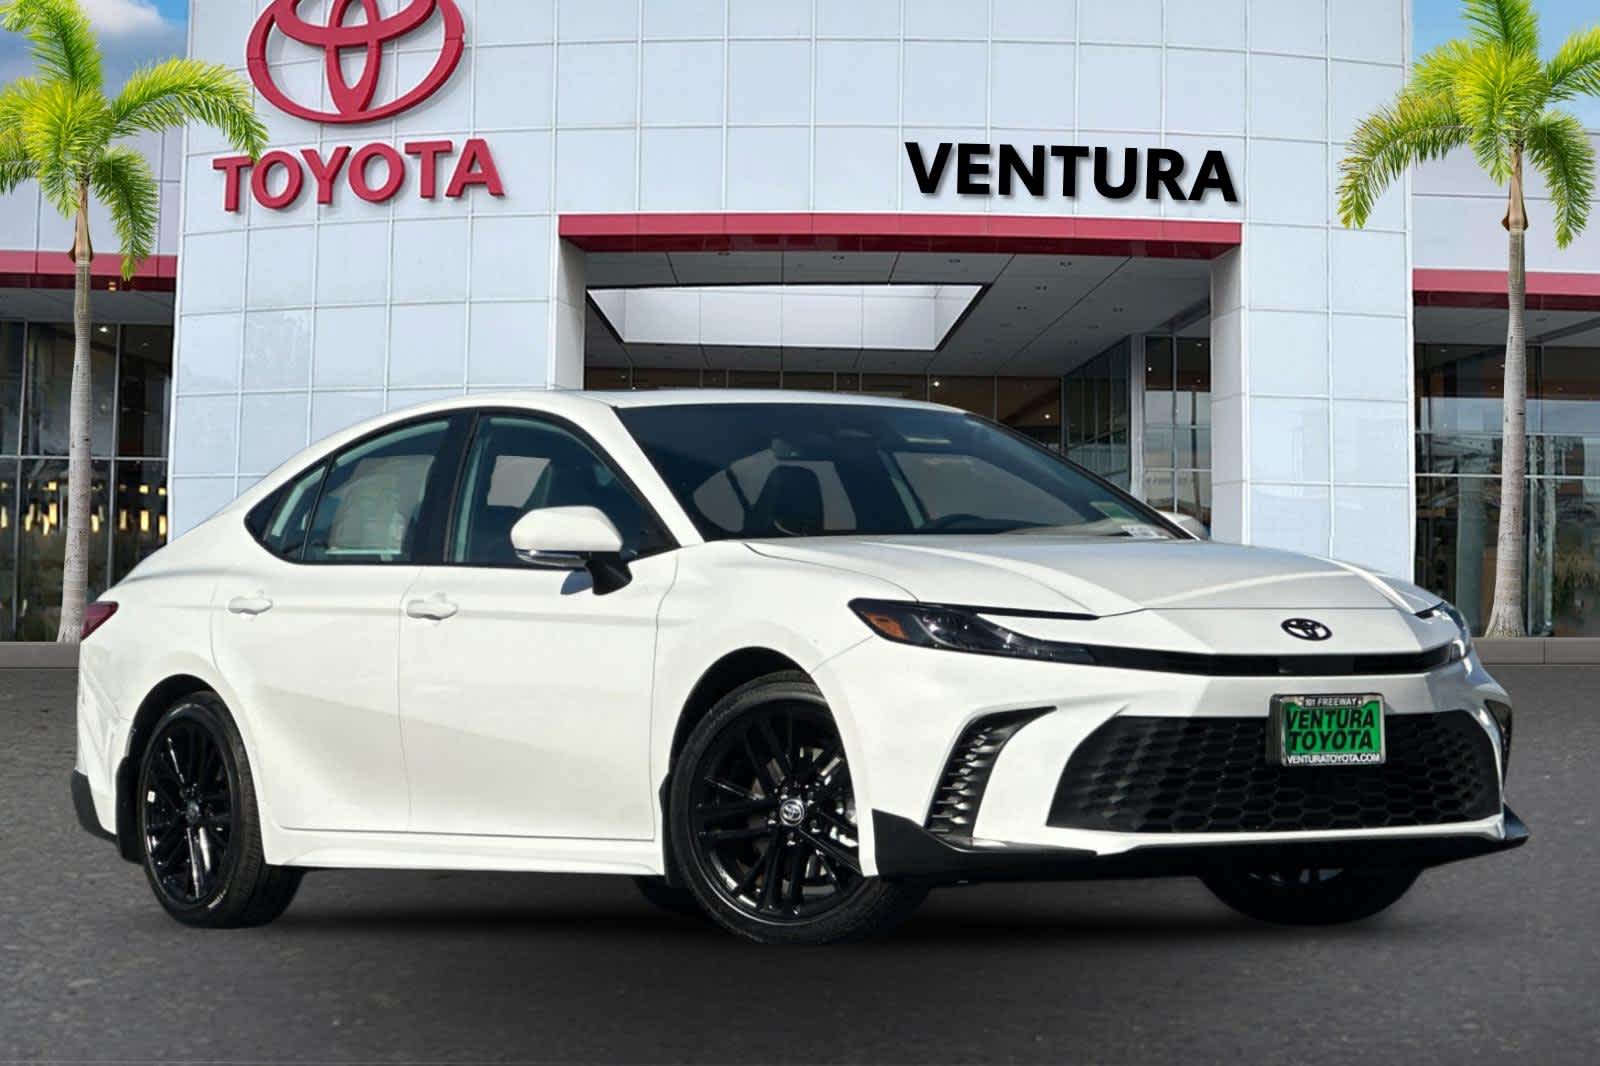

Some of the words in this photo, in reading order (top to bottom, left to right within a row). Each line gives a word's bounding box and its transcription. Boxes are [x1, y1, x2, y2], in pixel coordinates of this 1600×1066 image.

[213, 139, 505, 212] TOYOTA
[904, 142, 1240, 202] VENTURA
[1317, 697, 1358, 706] FREEWAY
[1287, 709, 1374, 729] VENTURA
[1289, 731, 1373, 750] TOYOTA
[1287, 754, 1380, 764] VENTURATOYOTA.COM
